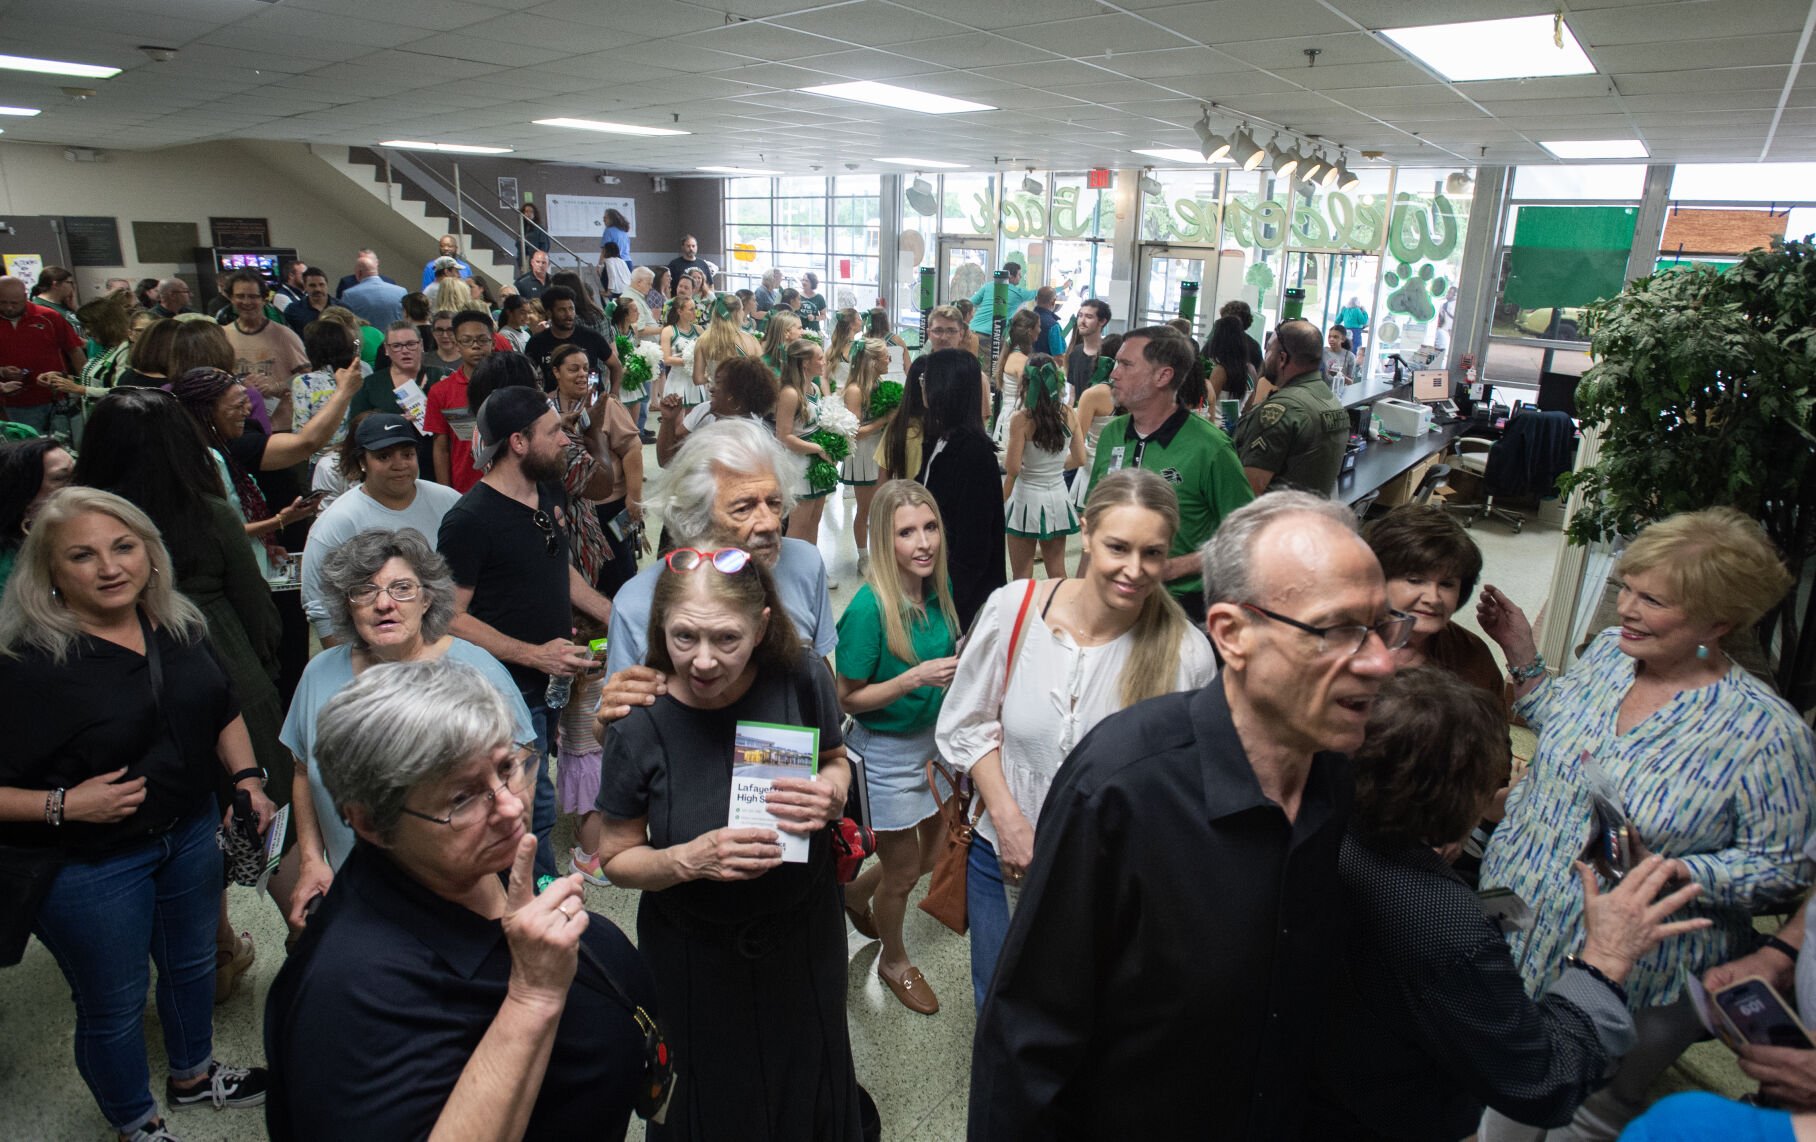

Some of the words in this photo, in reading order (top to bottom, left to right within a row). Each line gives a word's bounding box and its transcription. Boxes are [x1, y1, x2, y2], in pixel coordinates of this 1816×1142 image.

[1090, 170, 1109, 188] EXIT
[991, 320, 1001, 360] LAFAYETTE
[737, 793, 758, 804] High
